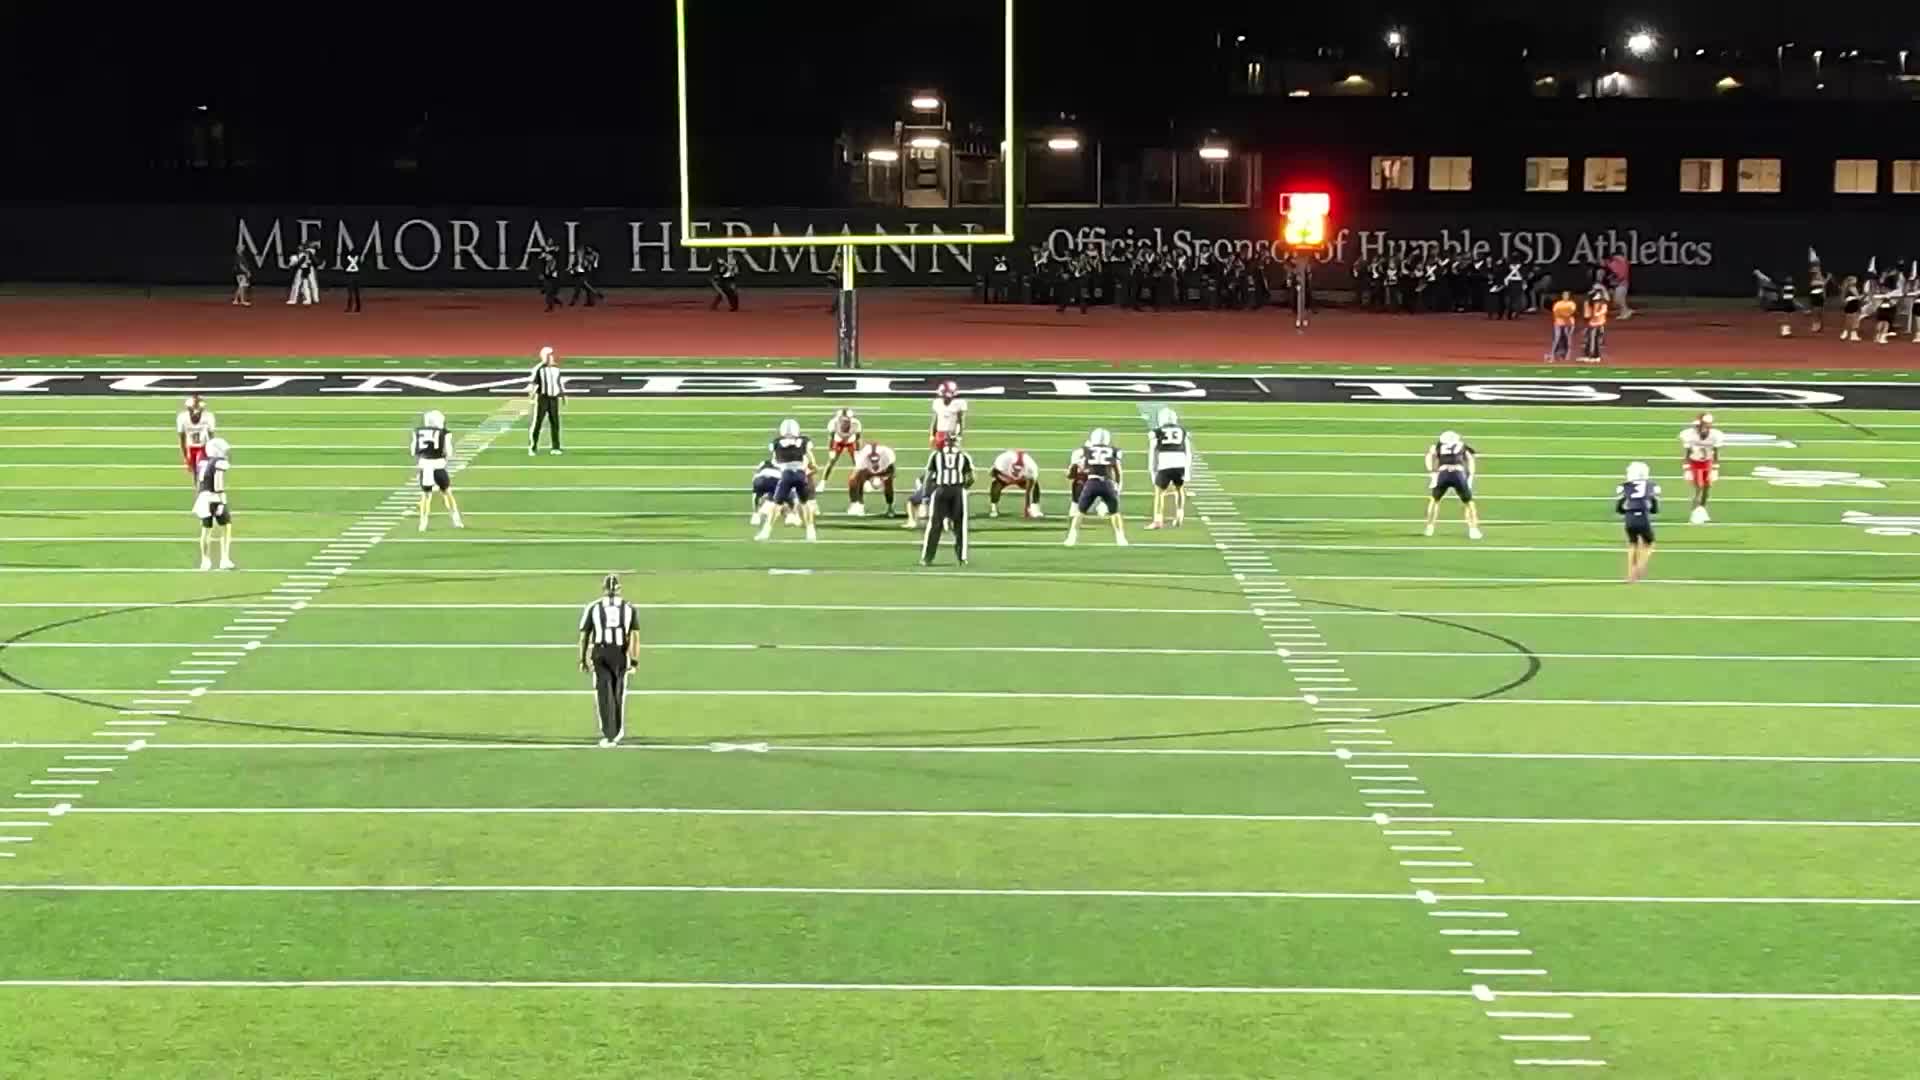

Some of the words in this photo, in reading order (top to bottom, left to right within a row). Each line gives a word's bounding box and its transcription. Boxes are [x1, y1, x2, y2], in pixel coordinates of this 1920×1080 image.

[629, 221, 976, 273] HERMANN
[1497, 231, 1563, 265] ISD
[1568, 228, 1713, 267] Athletics
[1334, 382, 1845, 404] ISD
[1161, 427, 1184, 445] 33
[1086, 448, 1114, 465] 32
